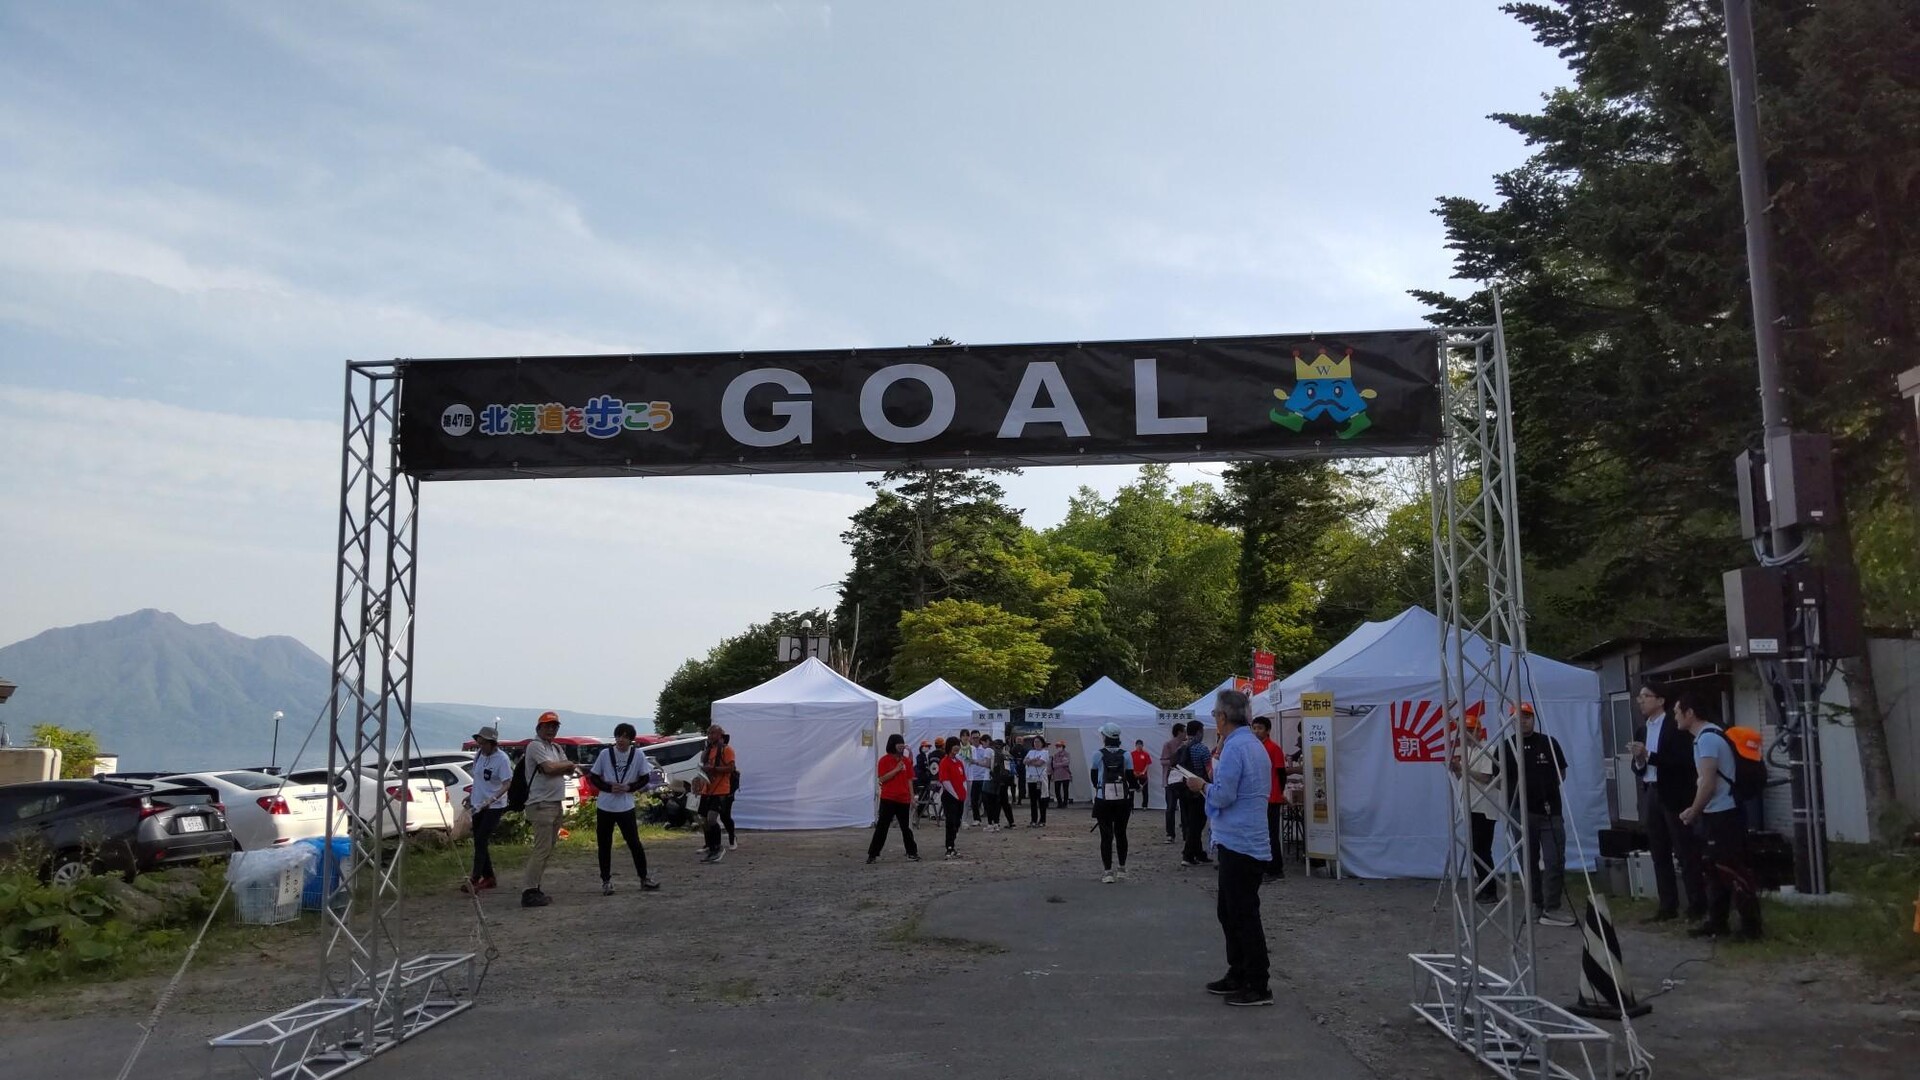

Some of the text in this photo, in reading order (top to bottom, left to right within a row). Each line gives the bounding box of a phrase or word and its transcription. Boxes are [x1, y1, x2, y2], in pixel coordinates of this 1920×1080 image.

[1317, 365, 1331, 375] W
[721, 358, 1208, 447] GOAL
[480, 395, 673, 439] 北海道を歩こう
[1303, 699, 1331, 711] 配布中
[1397, 735, 1421, 758] 朝
